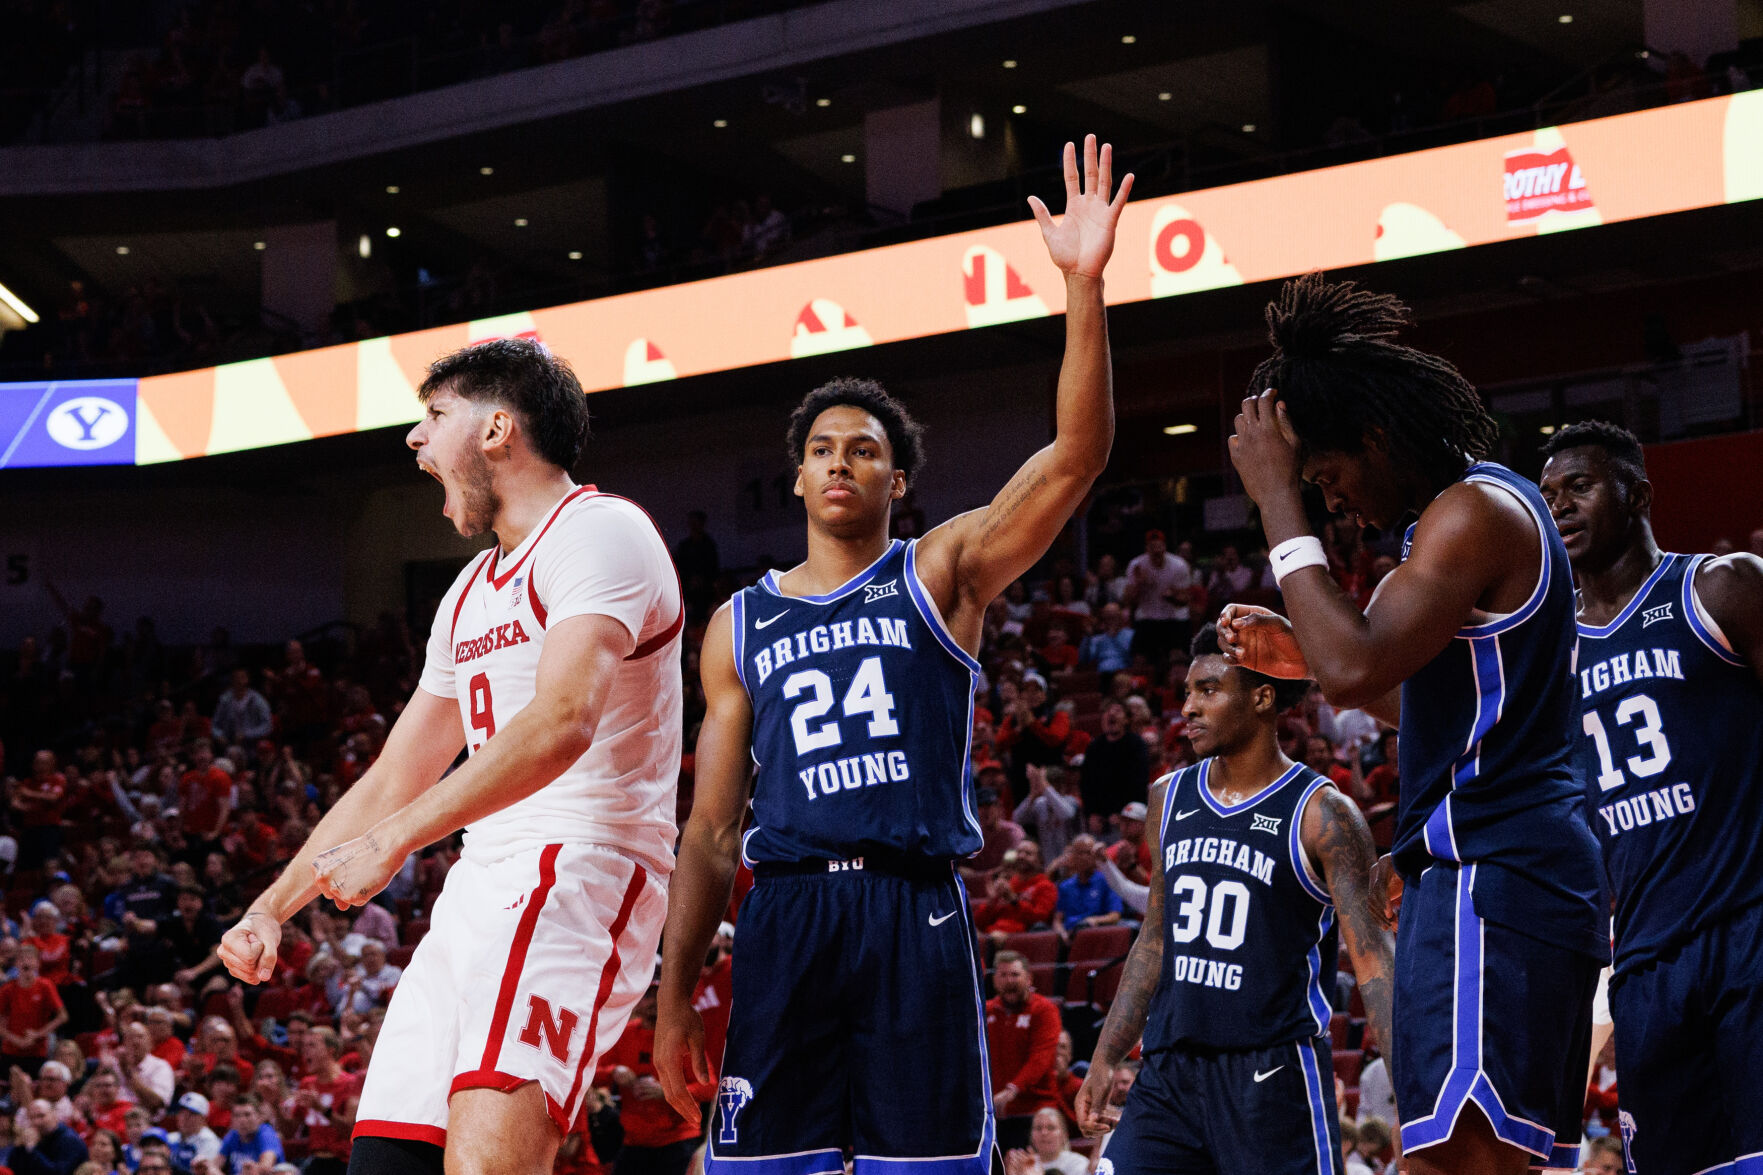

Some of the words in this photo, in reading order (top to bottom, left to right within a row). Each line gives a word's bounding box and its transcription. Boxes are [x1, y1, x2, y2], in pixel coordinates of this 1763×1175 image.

[63, 406, 112, 441] Y
[455, 619, 531, 665] NEBRASKA
[754, 616, 912, 687] BRIGHAM
[1580, 648, 1685, 699] IGHAM
[469, 671, 496, 753] 9
[781, 655, 901, 757] 24
[1582, 693, 1672, 792] 13
[799, 750, 911, 801] YOUNG
[1598, 782, 1696, 836] YOUNG
[1165, 837, 1276, 887] BRIGHAM
[1172, 874, 1250, 951] 30
[1174, 955, 1244, 991] OUNG
[517, 993, 580, 1069] N
